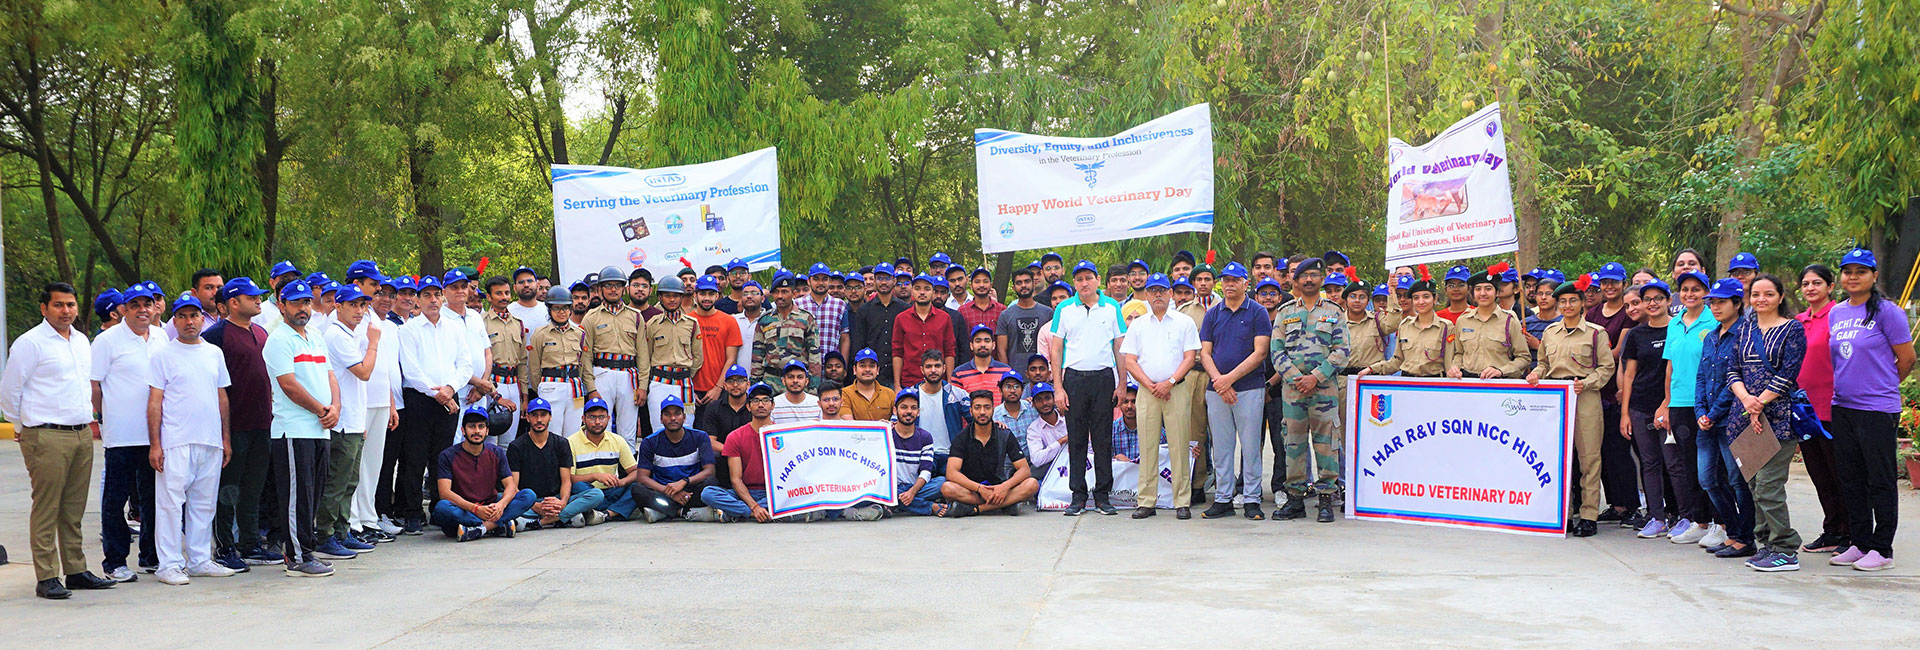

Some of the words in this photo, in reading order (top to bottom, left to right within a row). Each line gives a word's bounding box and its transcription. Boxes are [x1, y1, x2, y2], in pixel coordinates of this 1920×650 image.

[990, 143, 1041, 156] Diversity,
[1044, 142, 1085, 153] Equity,
[1087, 140, 1110, 150] and
[1112, 128, 1194, 147] Inclusiveness
[1039, 157, 1046, 165] in
[1047, 156, 1059, 164] the
[1060, 153, 1100, 163] Veterinary
[1102, 149, 1142, 159] Profession
[1479, 148, 1504, 171] ay
[648, 174, 682, 185] INTAS
[563, 194, 617, 211] Serving
[619, 193, 640, 207] the
[643, 190, 707, 204] Veterinary
[710, 182, 769, 199] Profession
[997, 203, 1039, 216] Happy
[1042, 196, 1083, 210] World
[1087, 189, 1161, 206] Veterinary
[1164, 186, 1193, 201] Day
[1412, 224, 1444, 237] University
[1446, 223, 1454, 232] of
[1456, 218, 1497, 230] Veterinary
[1498, 214, 1512, 225] and
[1397, 239, 1418, 251] Animal
[1420, 236, 1451, 248] Sciences,
[1452, 233, 1475, 243] Hisar
[1836, 330, 1859, 341] GANT
[779, 460, 797, 483] HAR
[796, 448, 816, 464] R&V
[818, 446, 836, 457] SQN
[839, 447, 858, 461] NCC
[860, 455, 886, 477] HISAR
[1363, 467, 1375, 479] 1
[1372, 435, 1405, 467] HAR
[1405, 421, 1437, 443] R&V
[1441, 419, 1473, 435] SQN
[1477, 422, 1510, 445] NCC
[1512, 436, 1552, 488] HISAR
[787, 485, 814, 498] WORLD
[815, 483, 861, 494] VETERINARY
[863, 478, 877, 489] DAY
[1382, 481, 1425, 497] WORLD
[1428, 484, 1508, 504] VETERINARY
[1508, 490, 1532, 506] DAY
